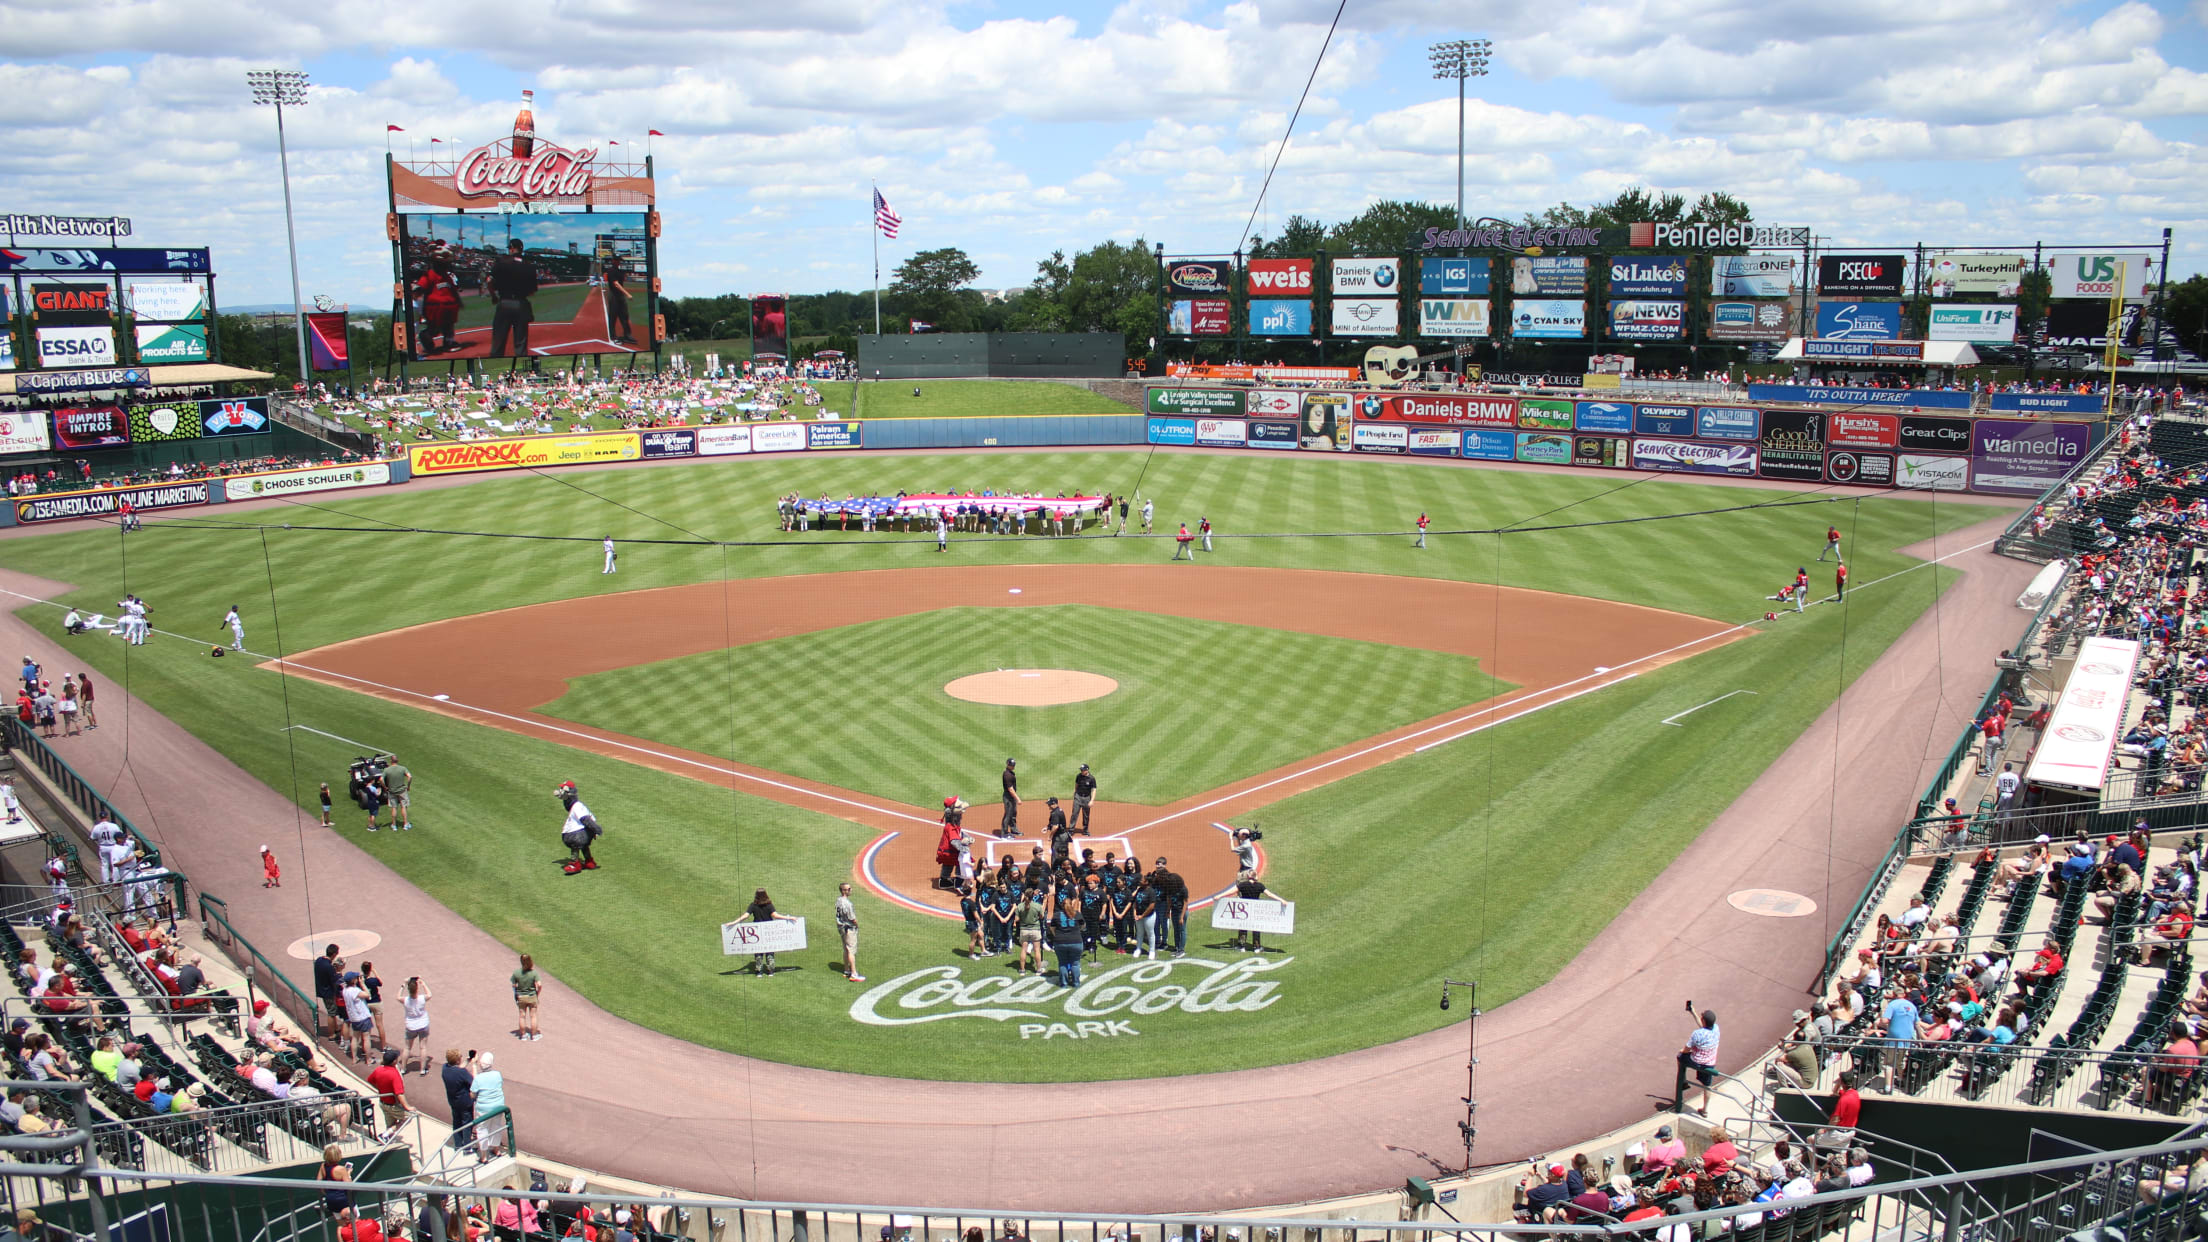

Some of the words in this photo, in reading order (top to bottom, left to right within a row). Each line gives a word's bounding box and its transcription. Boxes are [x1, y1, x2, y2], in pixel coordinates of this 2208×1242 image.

[457, 147, 598, 198] Coca-Cola
[498, 201, 560, 215] PARK
[41, 216, 128, 236] Network
[1423, 226, 1505, 249] SERVICE
[1509, 226, 1601, 248] ELECTRIC
[1655, 221, 1793, 247] PenTeleData
[1336, 266, 1371, 276] Daniels
[1445, 268, 1466, 280] IGS
[1611, 265, 1630, 281] St
[1839, 262, 1878, 281] PSECU
[2077, 256, 2115, 282] US
[1250, 266, 1310, 288] weis
[1340, 278, 1366, 286] BMW
[135, 286, 167, 295] Working
[2076, 283, 2113, 293] FOODS
[36, 291, 107, 311] GIANT
[135, 297, 158, 307] Living
[1424, 302, 1482, 321] WM
[1635, 305, 1679, 318] NEWS
[1264, 313, 1284, 330] ppl
[1534, 317, 1559, 325] CYAN
[1563, 317, 1583, 325] SKY
[1833, 305, 1887, 332] Shane
[1936, 314, 1970, 322] UniFirst
[42, 340, 91, 355] ESSA
[172, 341, 185, 349] AIR
[1808, 343, 1832, 353] BUD
[1834, 344, 1869, 354] LIGHT
[142, 348, 186, 357] PRODUCTS
[95, 355, 112, 363] Trust
[31, 372, 81, 390] Capital
[1481, 372, 1511, 383] CEDAR
[1542, 373, 1581, 386] COLLEGE
[1833, 390, 1868, 400] OUTTA
[2040, 399, 2069, 407] LIGHT
[1403, 399, 1463, 417] Daniels
[1467, 402, 1512, 420] BMW
[1522, 407, 1550, 418] Mike
[1553, 410, 1570, 420] Ike
[1641, 407, 1688, 417] OLYMPUS
[68, 412, 112, 423] UMPIRE
[211, 408, 262, 426] VICTORY
[1834, 416, 1879, 427] Hursh's
[70, 423, 112, 433] INTROS
[810, 425, 840, 434] Palram
[1157, 426, 1193, 434] LUTRON
[1901, 426, 1935, 437] Great
[1937, 428, 1968, 441] Clips
[700, 433, 749, 443] AmericanBank
[759, 429, 798, 440] CareerLink
[811, 432, 851, 440] Americas
[1366, 430, 1388, 439] People
[1771, 428, 1808, 440] GOOD
[664, 443, 690, 451] team
[983, 438, 997, 446] 400
[1762, 437, 1824, 452] SHEPHERD
[1984, 435, 2077, 456] viamedia
[558, 451, 581, 460] Jeep
[1636, 444, 1675, 455] SERVICE
[1678, 446, 1724, 458] ELECTRIC
[1762, 451, 1822, 460] REHABILITATION
[1761, 462, 1822, 471] HomeRunRehab.org
[2019, 457, 2043, 465] Targeted
[1917, 470, 1962, 479] VISTACOM
[265, 479, 304, 490] CHOOSE
[307, 473, 352, 485] SCHULER
[119, 488, 154, 508] ONLINE
[154, 485, 206, 505] MARKETING
[101, 831, 110, 840] 41
[1019, 1020, 1140, 1040] PARK
